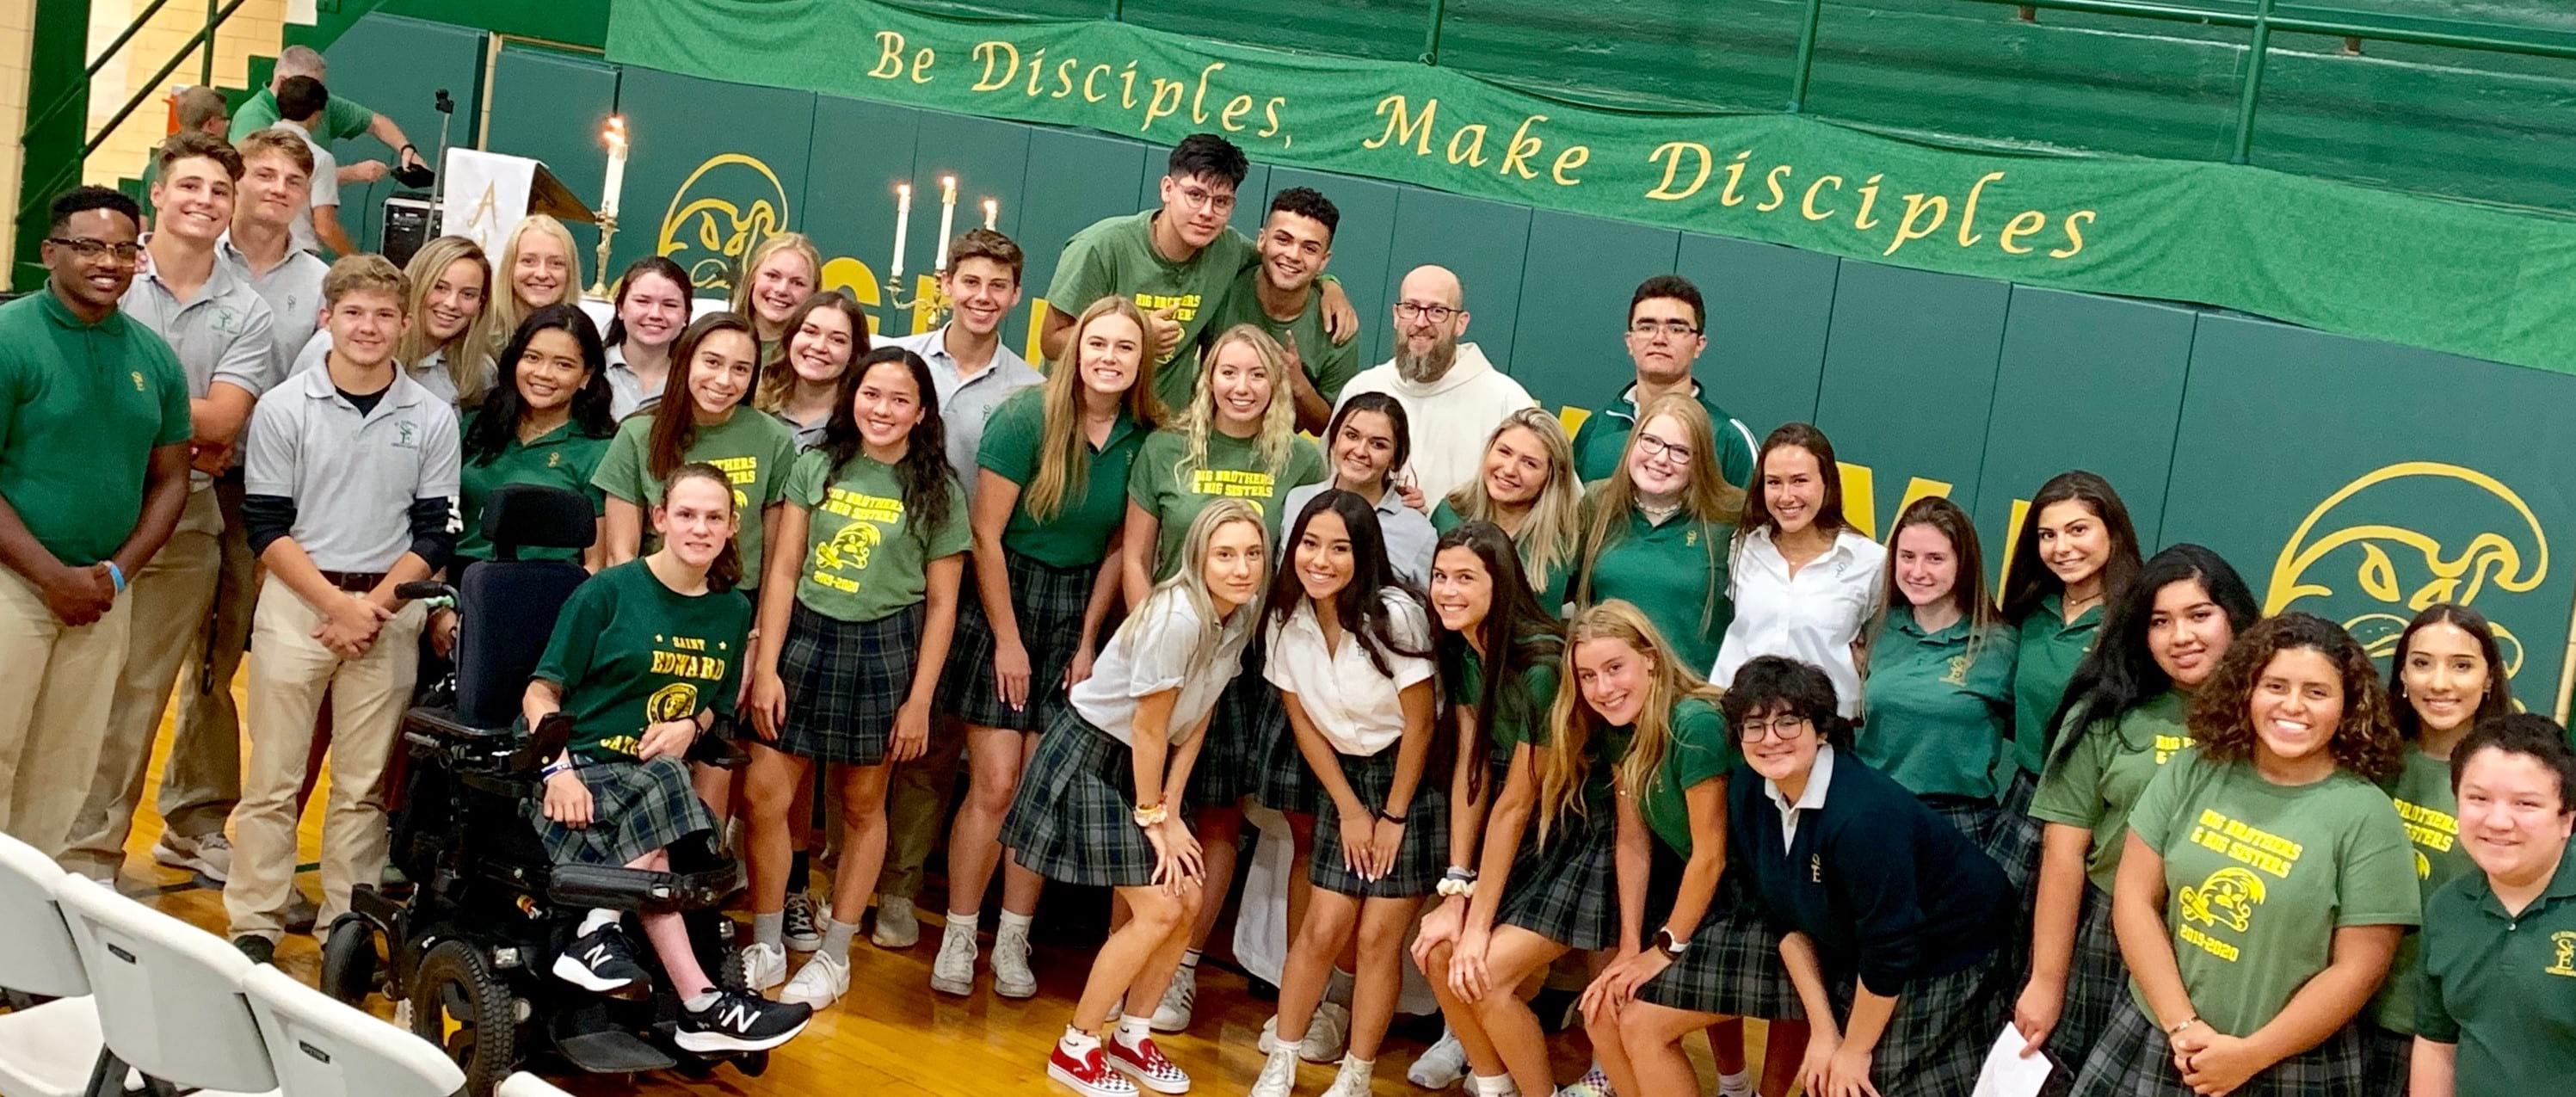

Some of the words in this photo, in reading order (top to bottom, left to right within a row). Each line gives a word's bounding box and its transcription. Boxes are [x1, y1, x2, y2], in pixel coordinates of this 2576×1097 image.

[867, 31, 935, 83] Be
[971, 40, 1291, 149] Disciples,
[1362, 95, 1590, 186] Make
[1644, 141, 2097, 258] Disciples
[1194, 470, 1213, 482] BIG
[1215, 470, 1275, 485] BROTHERS
[1203, 482, 1223, 495] BIG
[1224, 484, 1273, 497] SISTERS
[851, 506, 900, 524] SISTERS
[672, 636, 706, 651] SAINT
[650, 650, 725, 681] EDWARD
[2155, 735, 2180, 749] BIG
[2199, 808, 2227, 830] BIG
[2223, 819, 2303, 860] BROTHERS
[2201, 830, 2230, 853] BIG
[2228, 841, 2292, 878] SISTERS
[2179, 924, 2239, 962] 2019-2020
